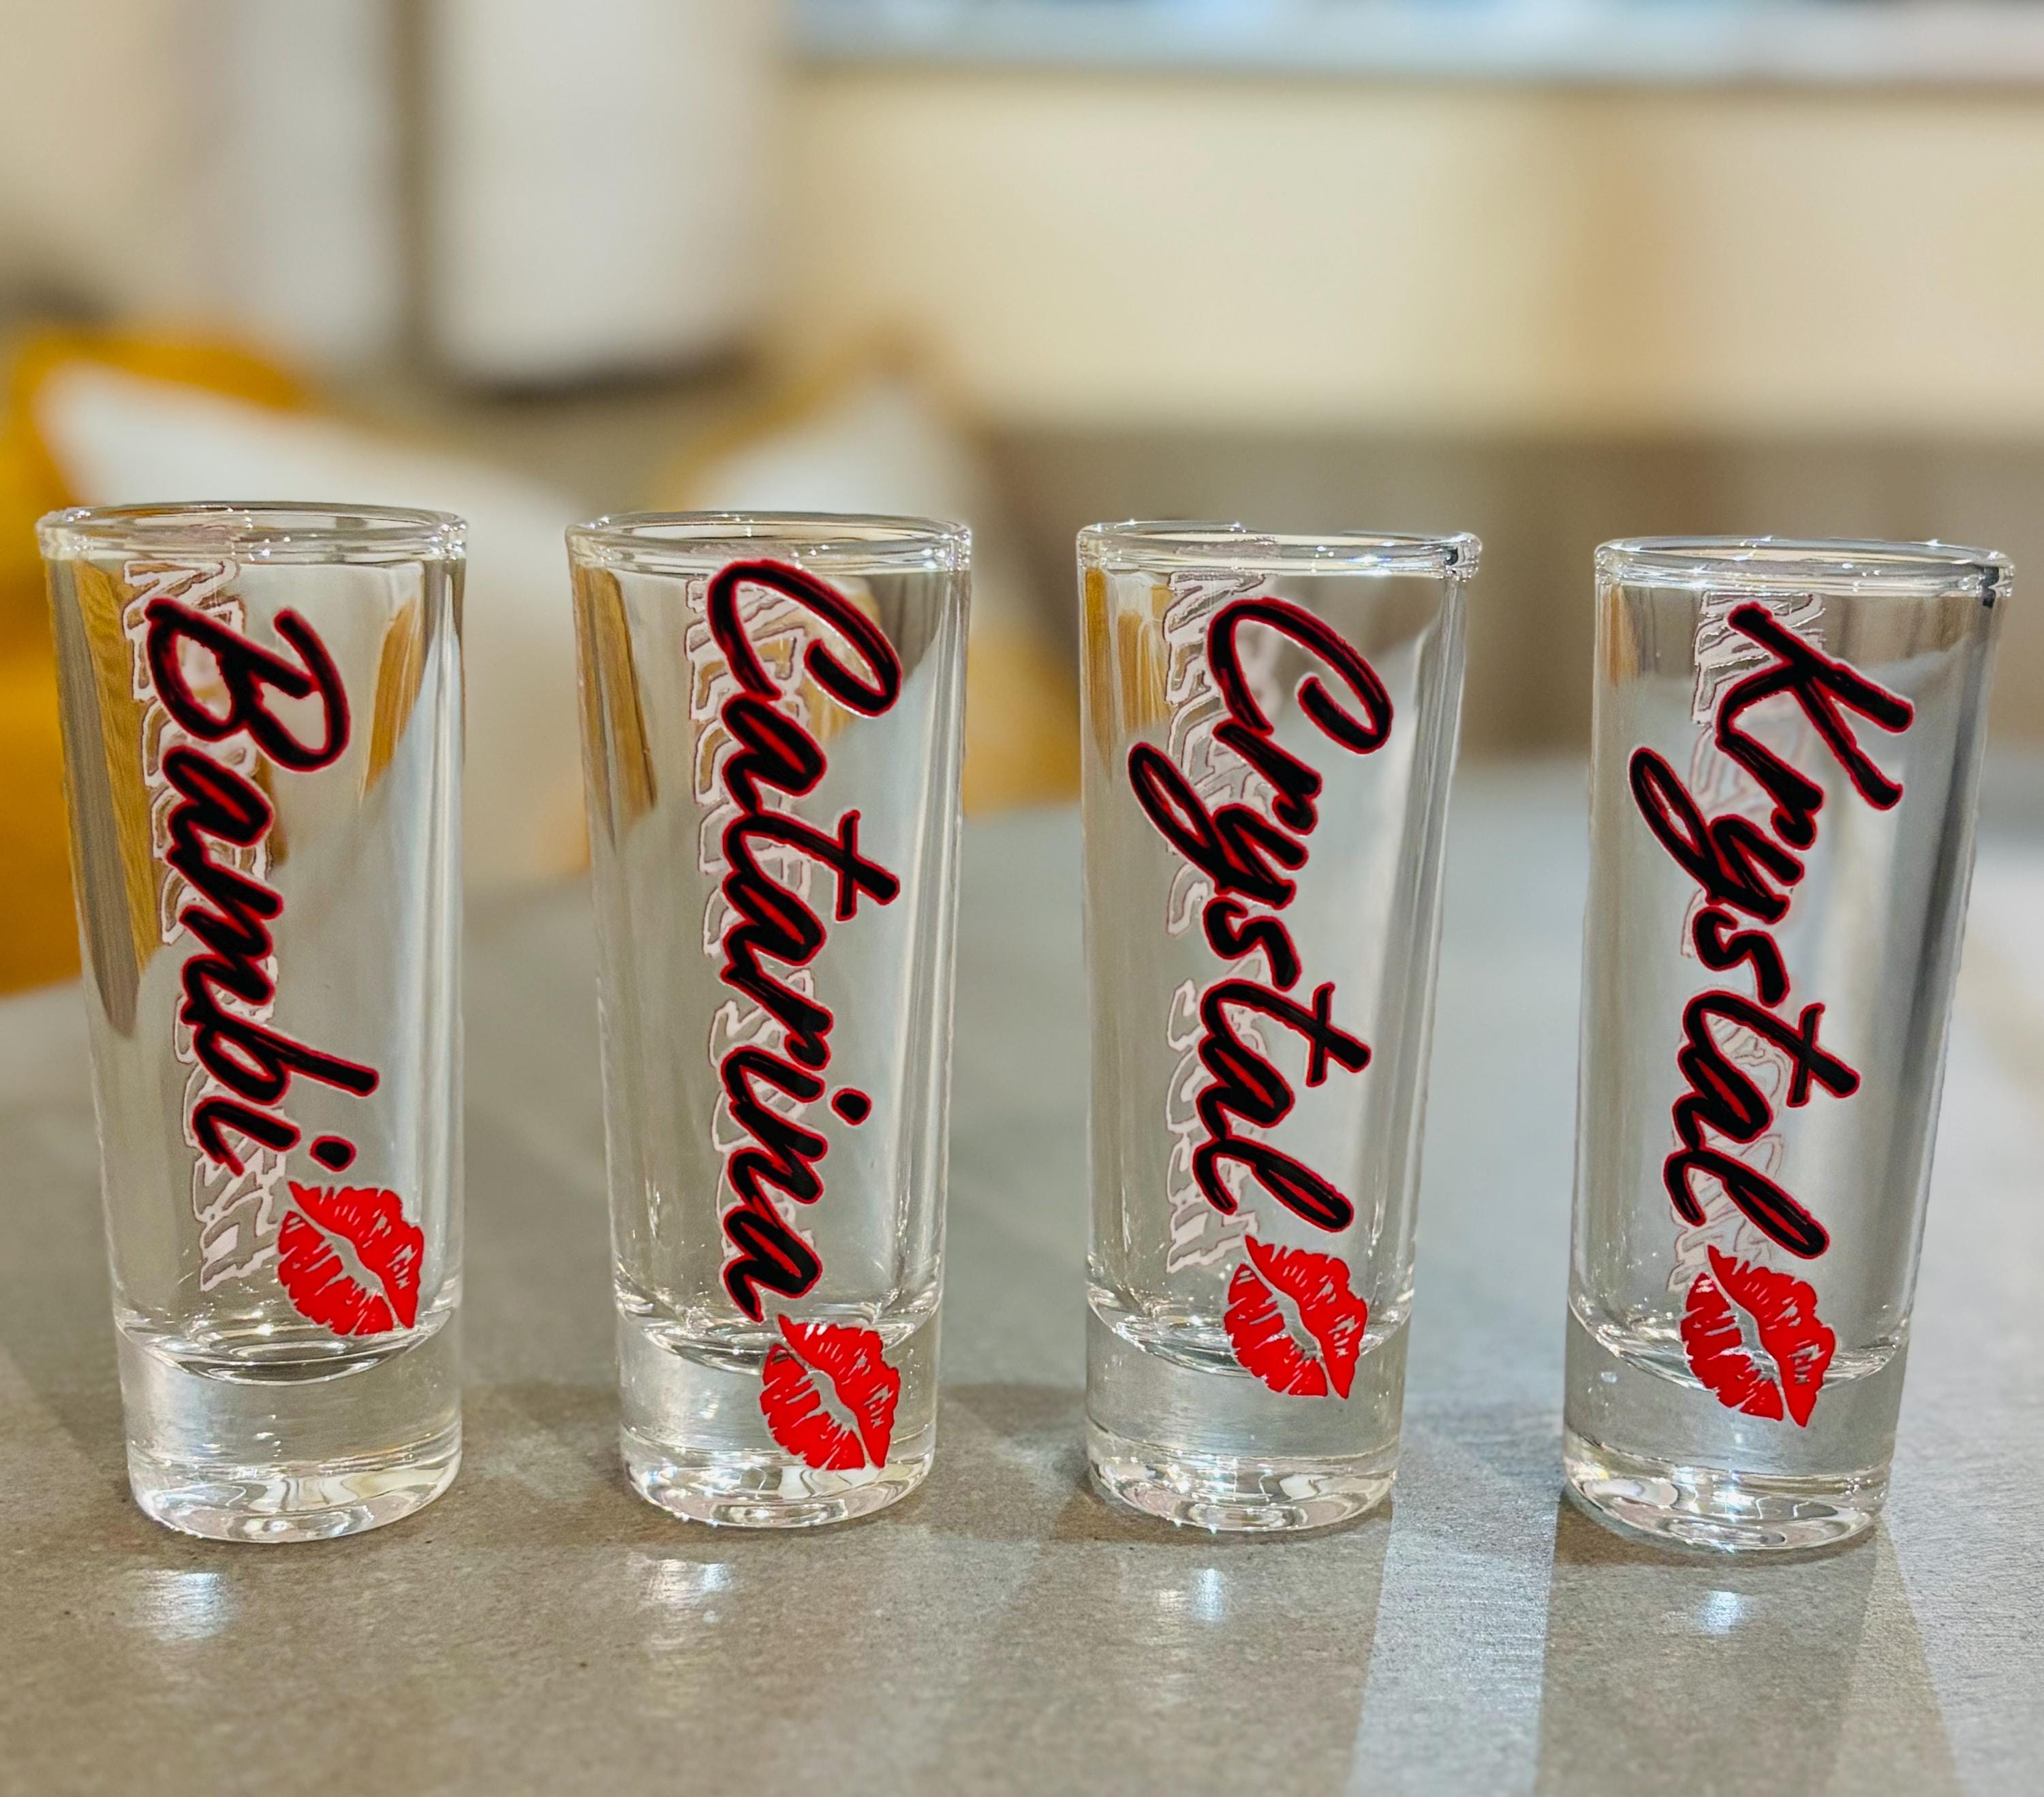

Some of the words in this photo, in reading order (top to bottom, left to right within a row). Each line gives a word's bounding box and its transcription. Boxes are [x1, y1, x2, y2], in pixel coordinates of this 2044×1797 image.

[143, 597, 380, 1177] Bambi
[707, 559, 902, 1324] Catarina
[1127, 596, 1394, 1234] Crystal
[1629, 601, 1914, 1260] Krystal
